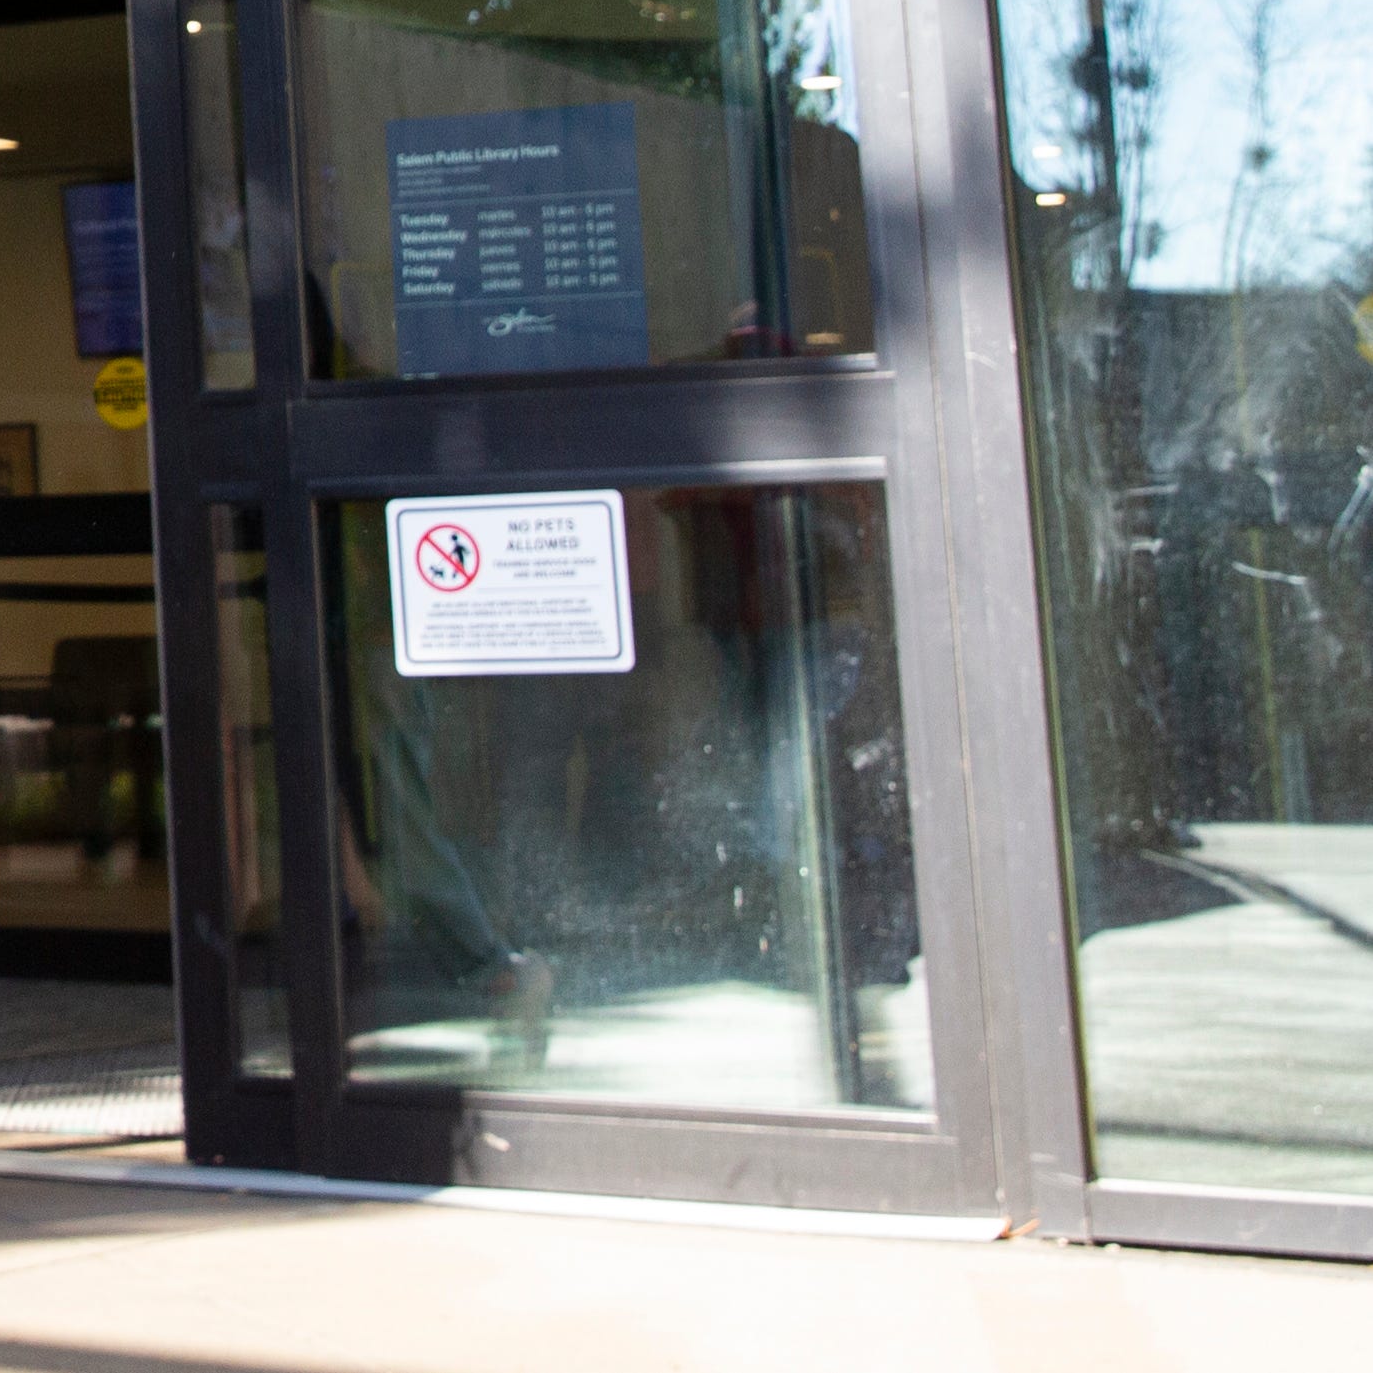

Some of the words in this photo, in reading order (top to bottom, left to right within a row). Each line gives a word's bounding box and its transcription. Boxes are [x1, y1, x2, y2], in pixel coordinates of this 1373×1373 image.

[397, 152, 434, 167] Salem
[435, 149, 474, 163] Public
[475, 146, 518, 162] Library
[520, 144, 560, 157] Hours
[400, 213, 449, 228] Tuesday
[542, 205, 556, 219] 10
[558, 207, 575, 217] am
[596, 204, 615, 218] pm
[400, 229, 468, 245] Wednesday
[543, 222, 557, 235] 10
[559, 224, 576, 234] am
[596, 221, 616, 235] pm
[402, 247, 455, 262] Thursday
[545, 240, 559, 253] 10
[560, 242, 577, 252] am
[597, 239, 617, 252] pm
[402, 265, 439, 279] Friday
[545, 257, 559, 271] 10
[561, 259, 580, 269] am
[598, 257, 618, 269] pm
[403, 281, 455, 296] Saturday
[546, 275, 560, 287] 10
[562, 277, 581, 287] am
[599, 274, 619, 286] pm
[508, 520, 529, 532] NO
[534, 517, 575, 532] PETS
[506, 537, 580, 552] ALLOWED
